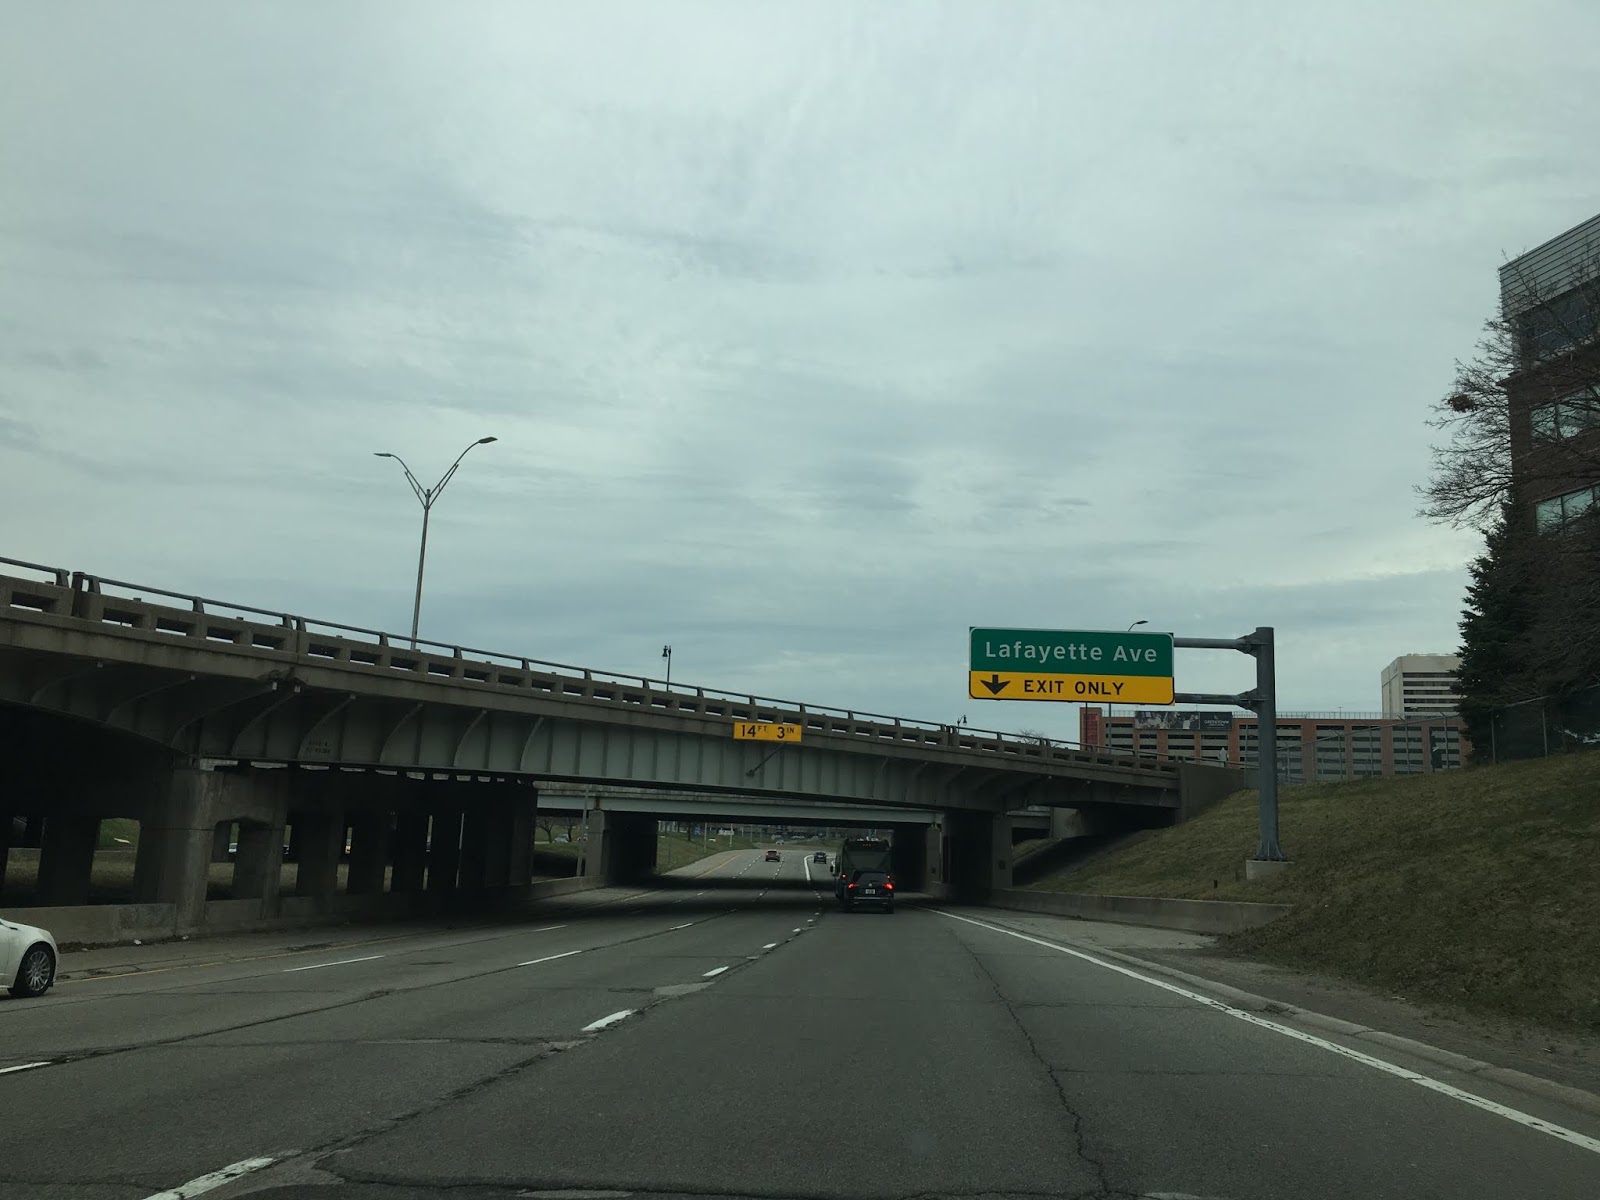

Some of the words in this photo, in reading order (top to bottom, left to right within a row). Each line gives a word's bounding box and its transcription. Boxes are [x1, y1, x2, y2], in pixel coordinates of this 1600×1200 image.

[985, 641, 1103, 664] Lafayette
[1113, 645, 1158, 663] Ave
[1024, 679, 1064, 693] EXIT
[1074, 680, 1124, 695] ONLY
[741, 724, 756, 738] 14
[777, 726, 785, 739] 3
